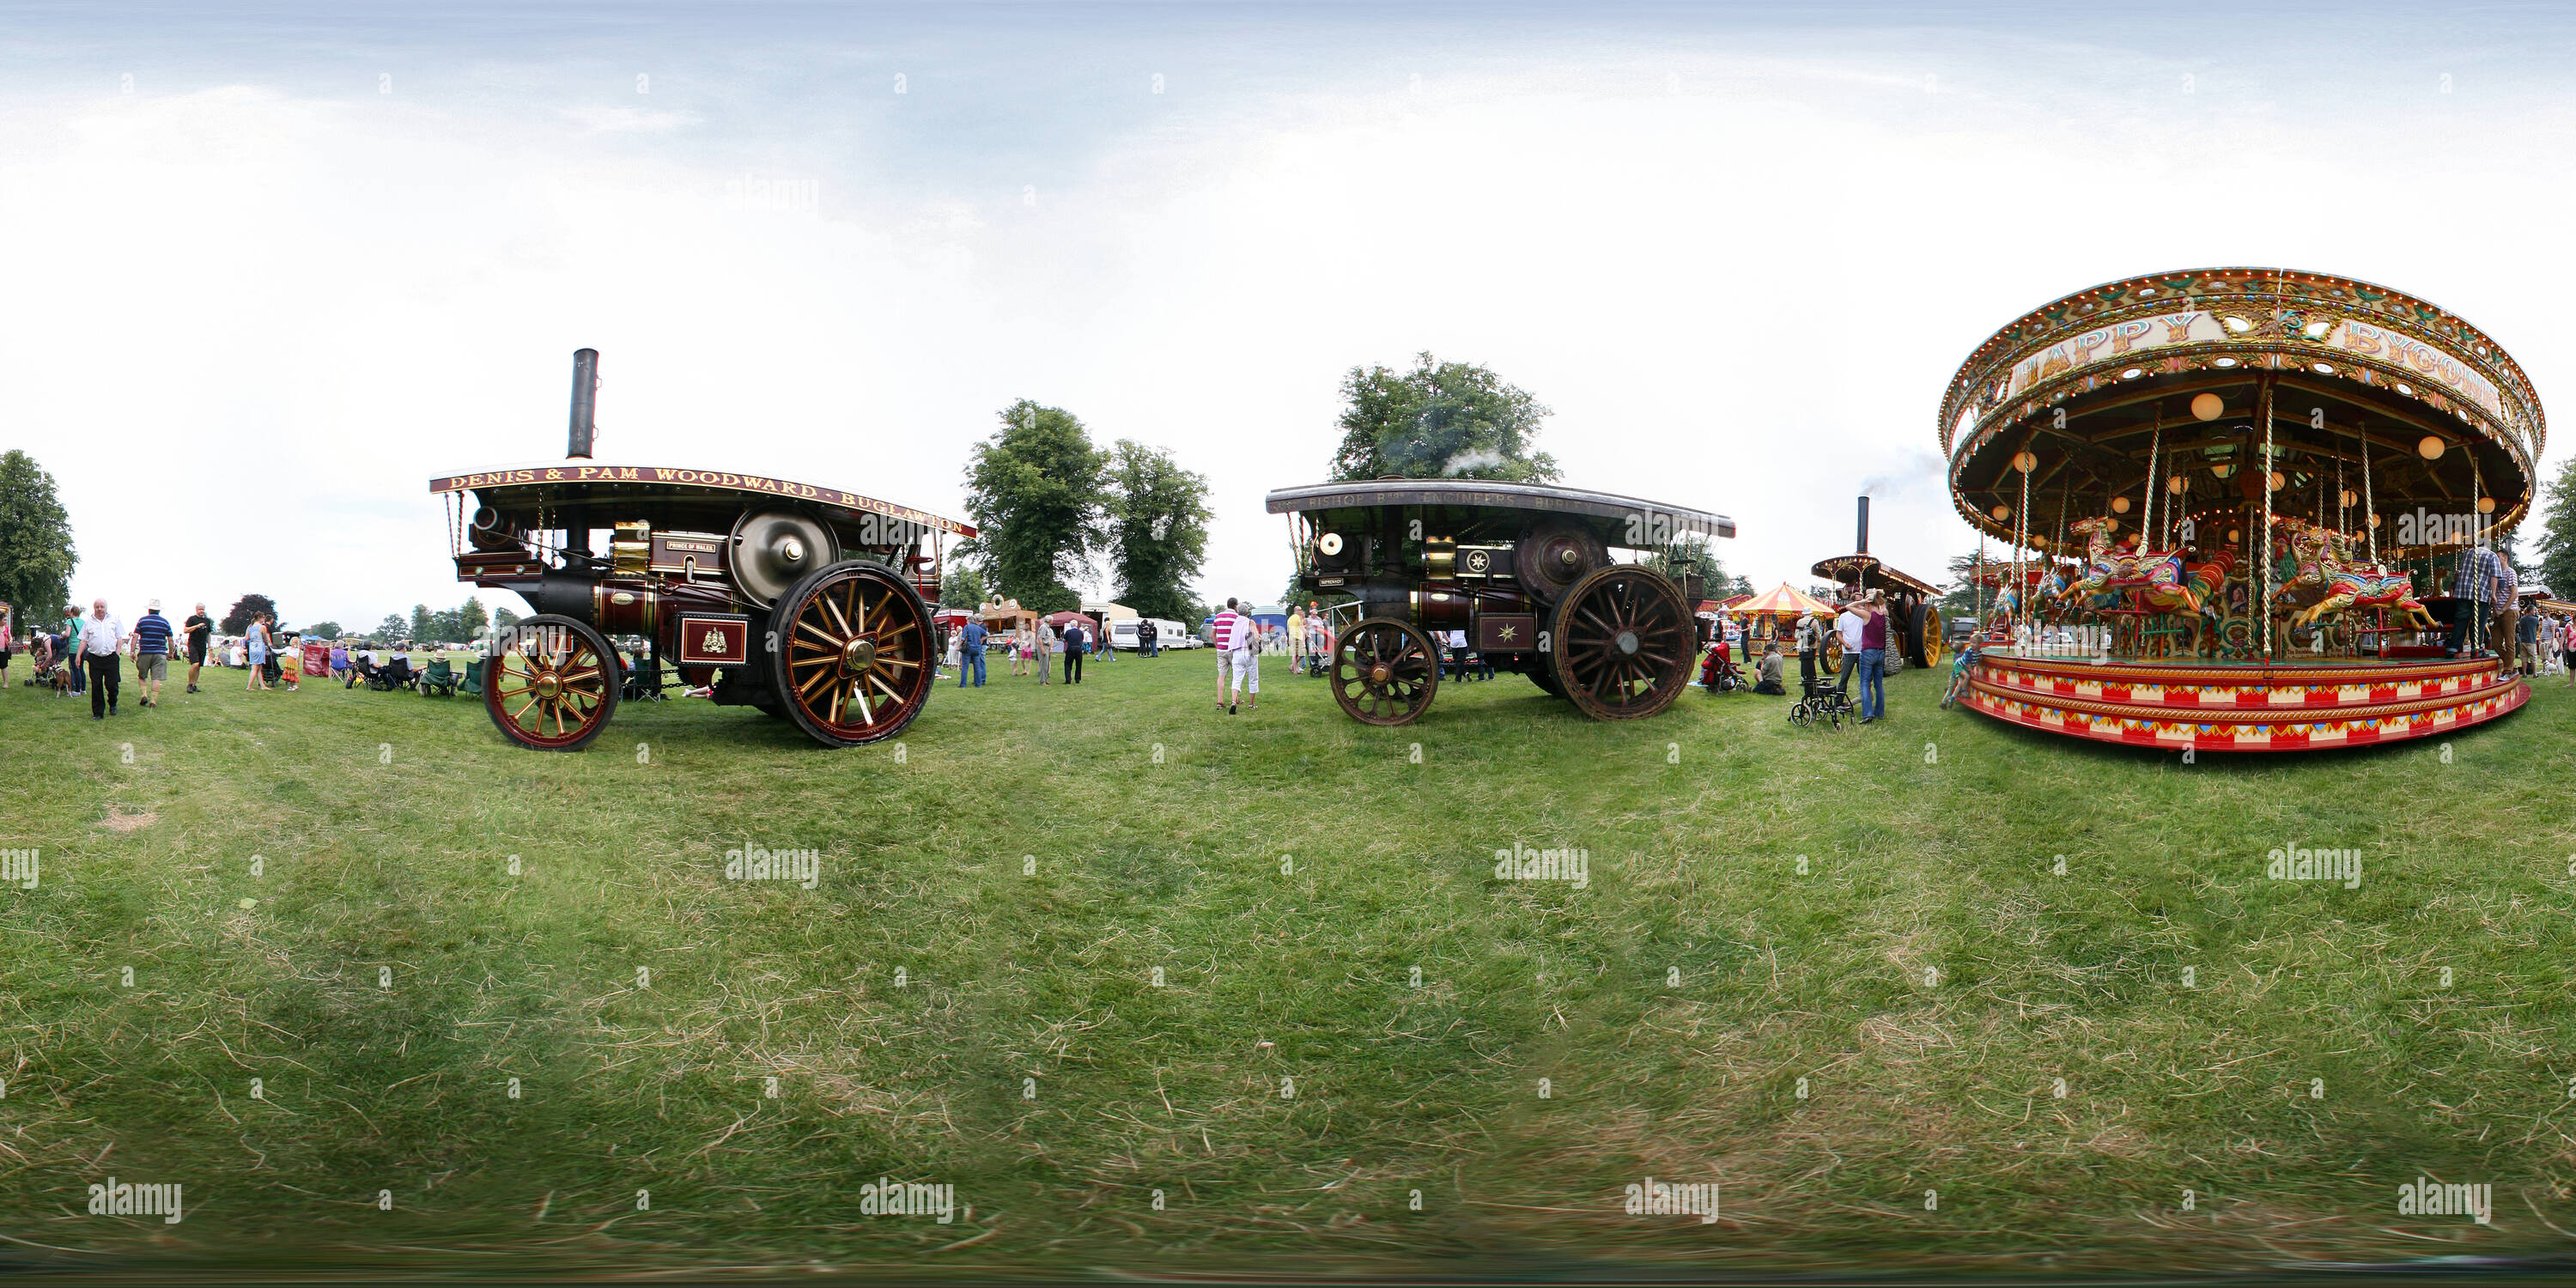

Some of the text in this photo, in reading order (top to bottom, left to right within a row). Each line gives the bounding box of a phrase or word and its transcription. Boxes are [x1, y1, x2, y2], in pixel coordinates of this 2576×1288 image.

[2016, 312, 2202, 392] HAPPY
[449, 467, 963, 533] DENIS & PAM WOODWARD BUGLAWTON
[1309, 495, 1364, 508] BISHOP
